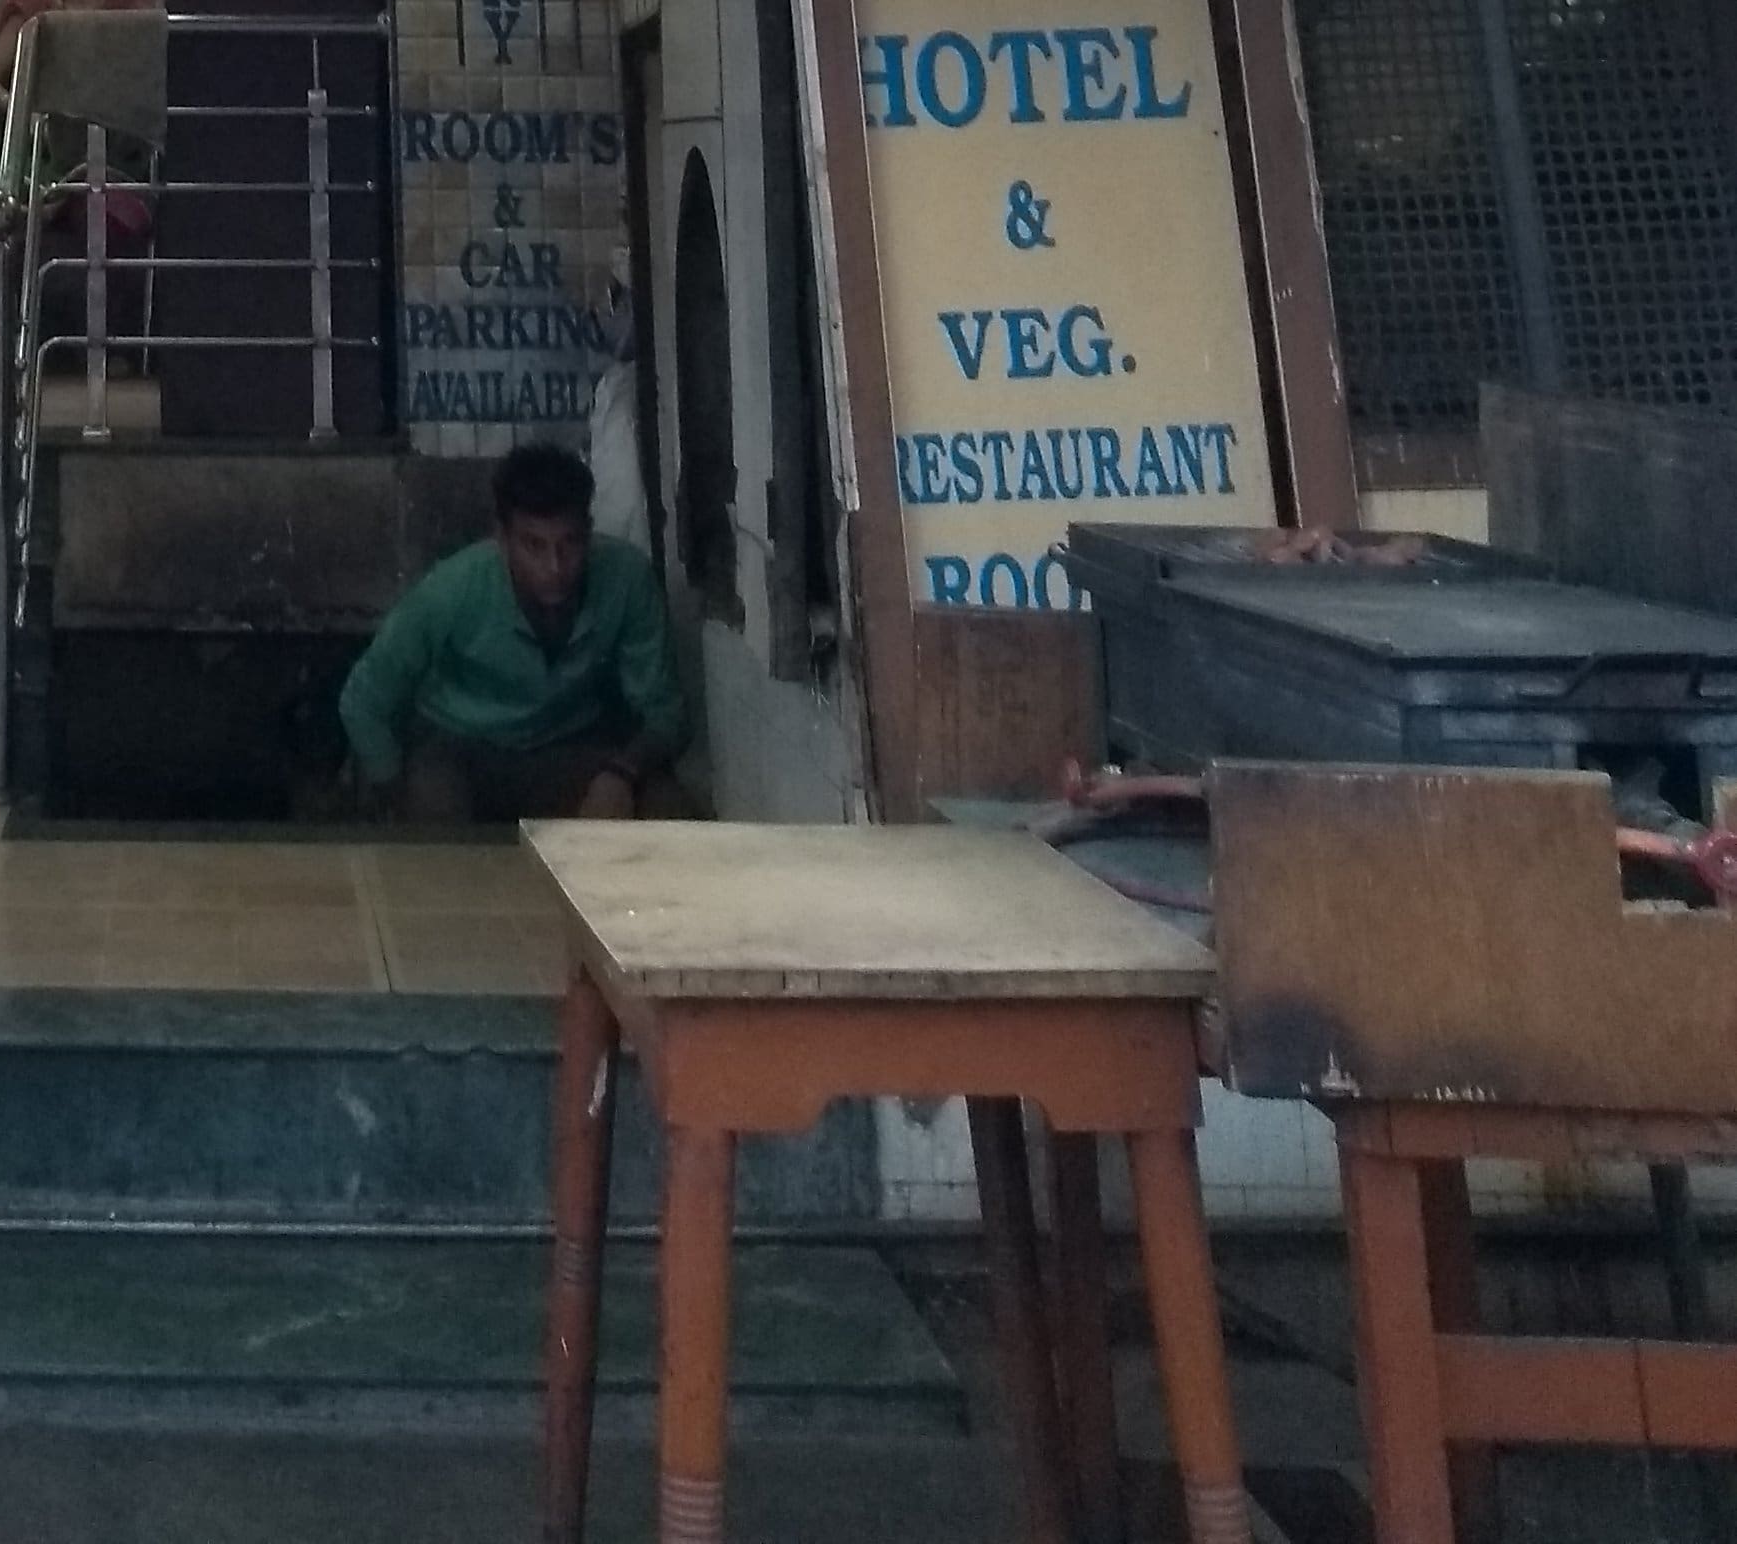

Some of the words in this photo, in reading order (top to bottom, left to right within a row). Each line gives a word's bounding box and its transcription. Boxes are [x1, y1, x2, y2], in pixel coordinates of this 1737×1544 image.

[860, 25, 1192, 129] HOTEL
[402, 112, 623, 164] ROOM'S
[494, 182, 526, 228] &
[1004, 179, 1055, 250] &
[460, 241, 562, 289] CAR
[938, 303, 1138, 380] VEG.
[409, 370, 600, 423] AVAILABL
